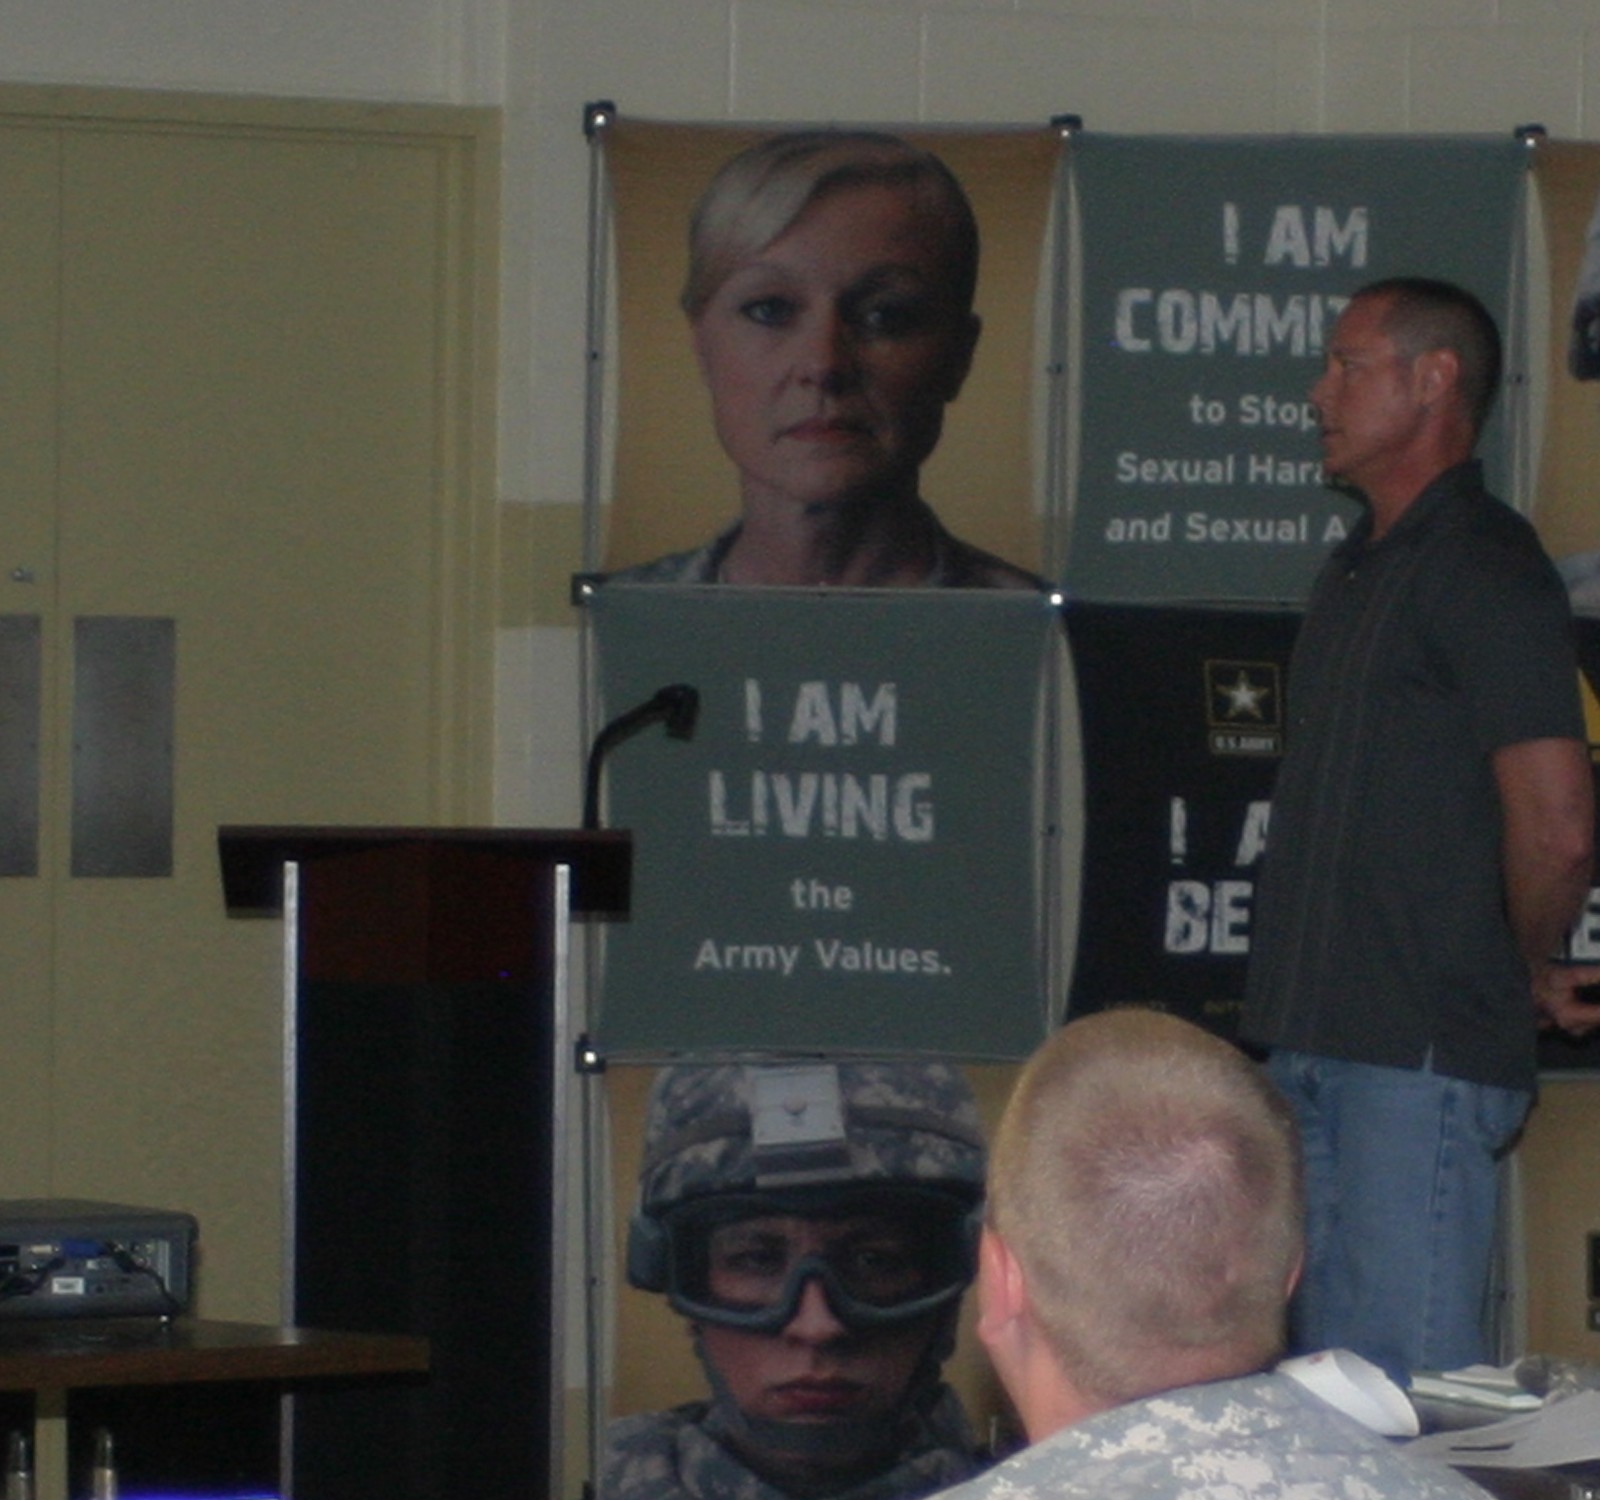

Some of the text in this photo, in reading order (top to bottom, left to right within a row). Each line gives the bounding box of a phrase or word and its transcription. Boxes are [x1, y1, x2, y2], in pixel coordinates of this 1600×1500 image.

[1222, 201, 1368, 268] I AM
[1190, 394, 1226, 426] to
[1117, 452, 1234, 484] Sexual
[1106, 511, 1347, 543] and Sexual A
[744, 677, 897, 746] I AM
[708, 769, 936, 841] LIVING
[1170, 796, 1187, 864] I
[790, 878, 853, 910] the
[1164, 879, 1254, 954] BE
[693, 939, 952, 976] Army Values.
